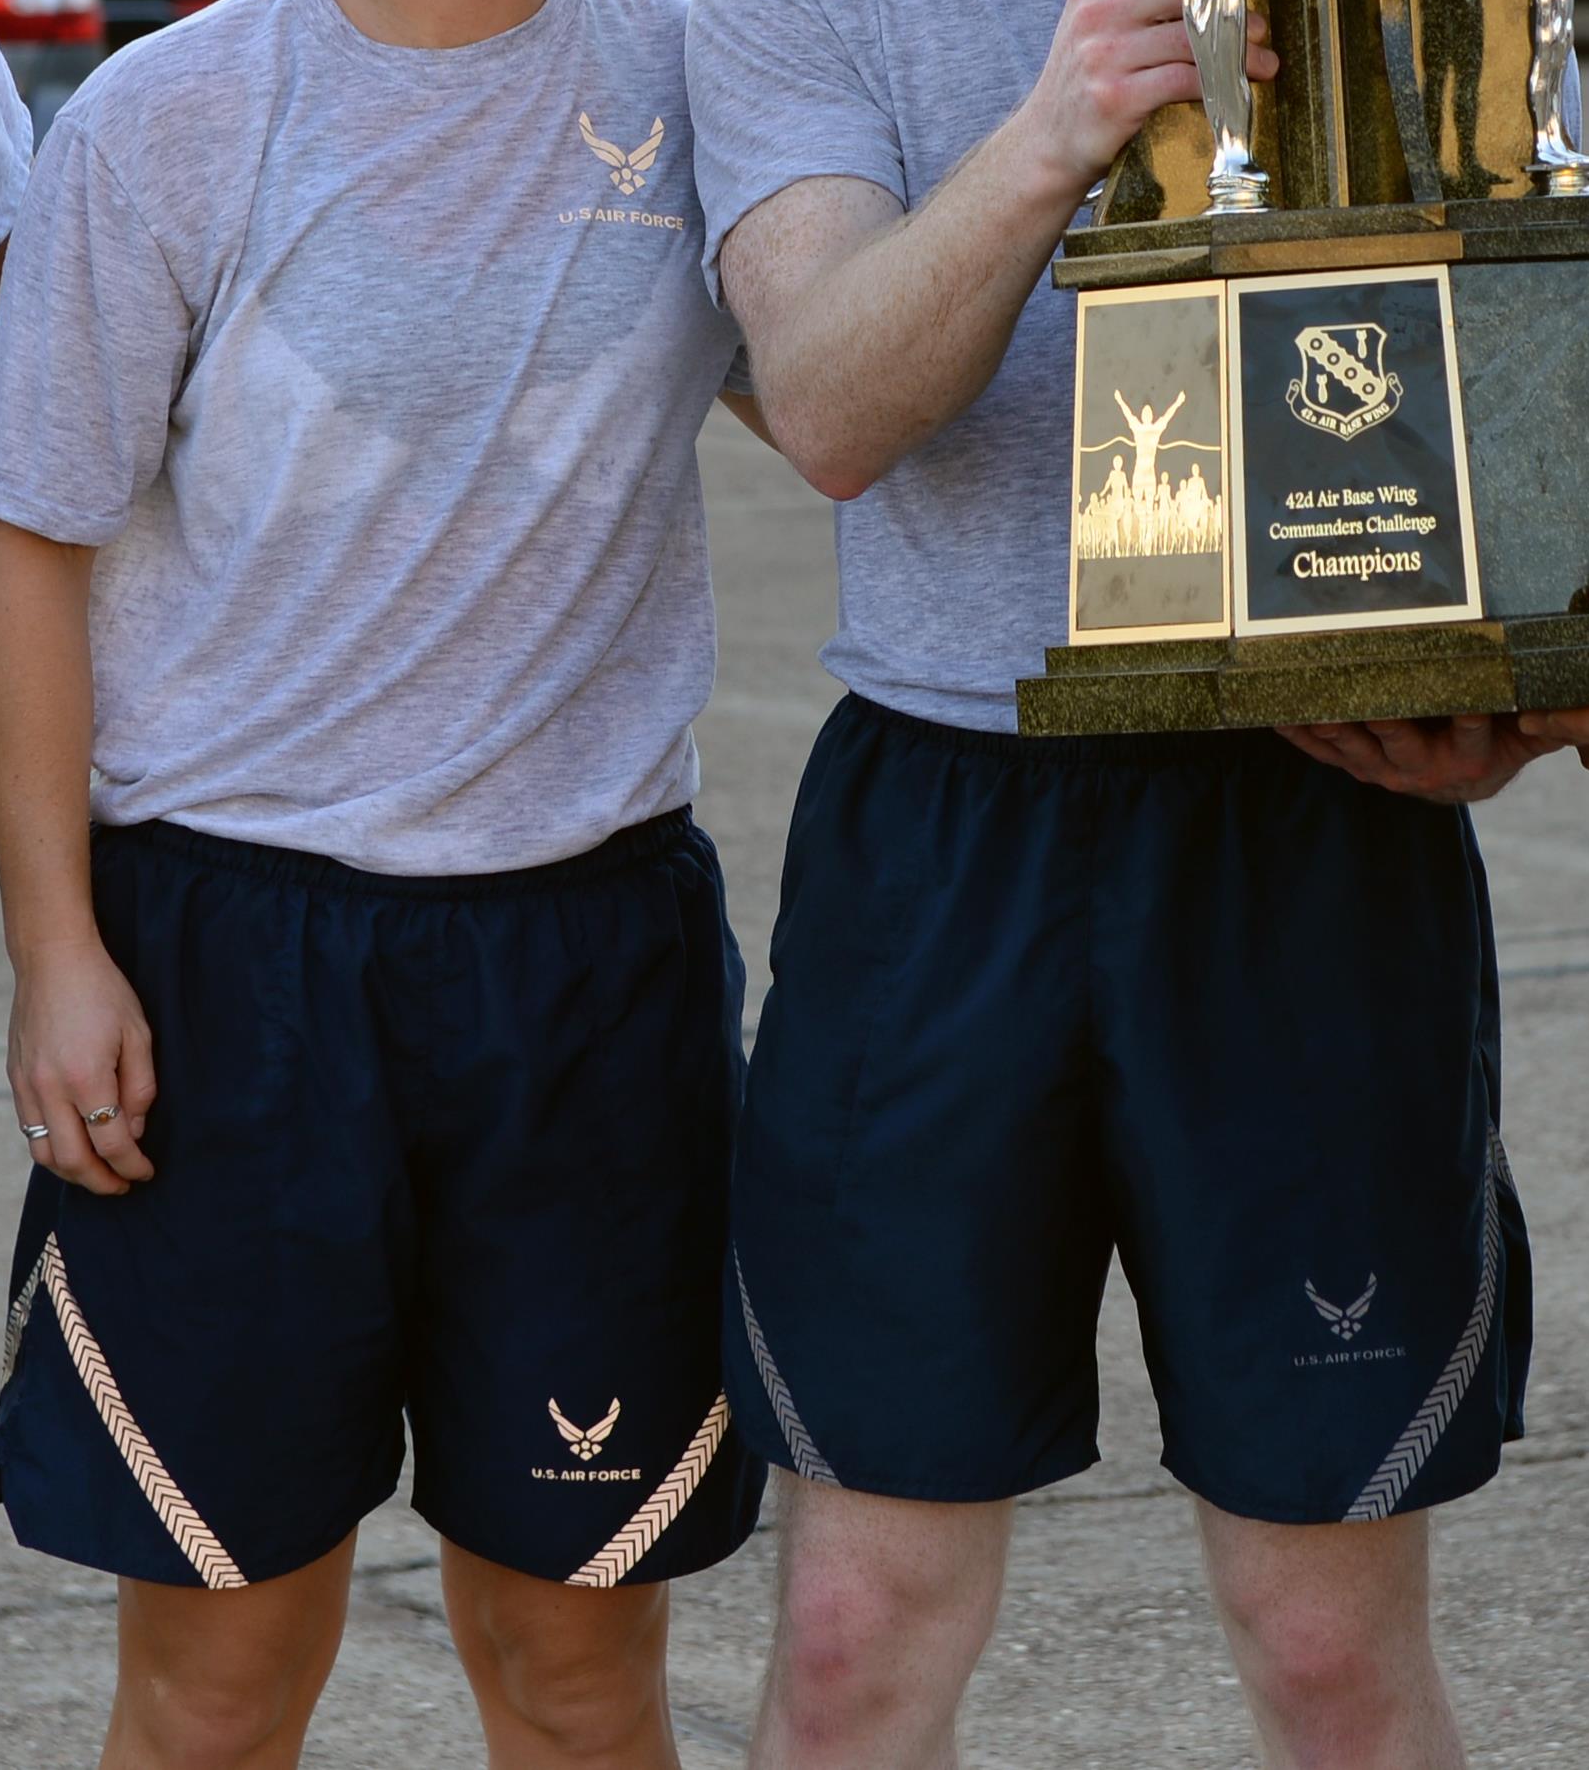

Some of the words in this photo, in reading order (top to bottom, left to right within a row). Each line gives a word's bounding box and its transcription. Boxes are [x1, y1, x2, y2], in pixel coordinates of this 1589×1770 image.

[595, 208, 626, 223] AIR
[630, 211, 685, 231] FORCE
[1318, 415, 1338, 430] AIR
[1339, 416, 1364, 436] BASE
[1362, 402, 1390, 423] WING
[1285, 490, 1315, 510] 42d
[1316, 488, 1341, 507] Air
[1342, 488, 1375, 506] Base
[1376, 485, 1418, 507] Wing
[1269, 518, 1364, 540] Commanders
[1366, 513, 1437, 535] Challenge
[1293, 546, 1422, 581] Champions
[1293, 1353, 1323, 1367] U.S.
[1325, 1352, 1350, 1364] AIR
[1353, 1345, 1407, 1361] FORCE
[531, 1467, 559, 1480] U.S.
[560, 1469, 586, 1481] AIR
[588, 1468, 641, 1482] FORCE
